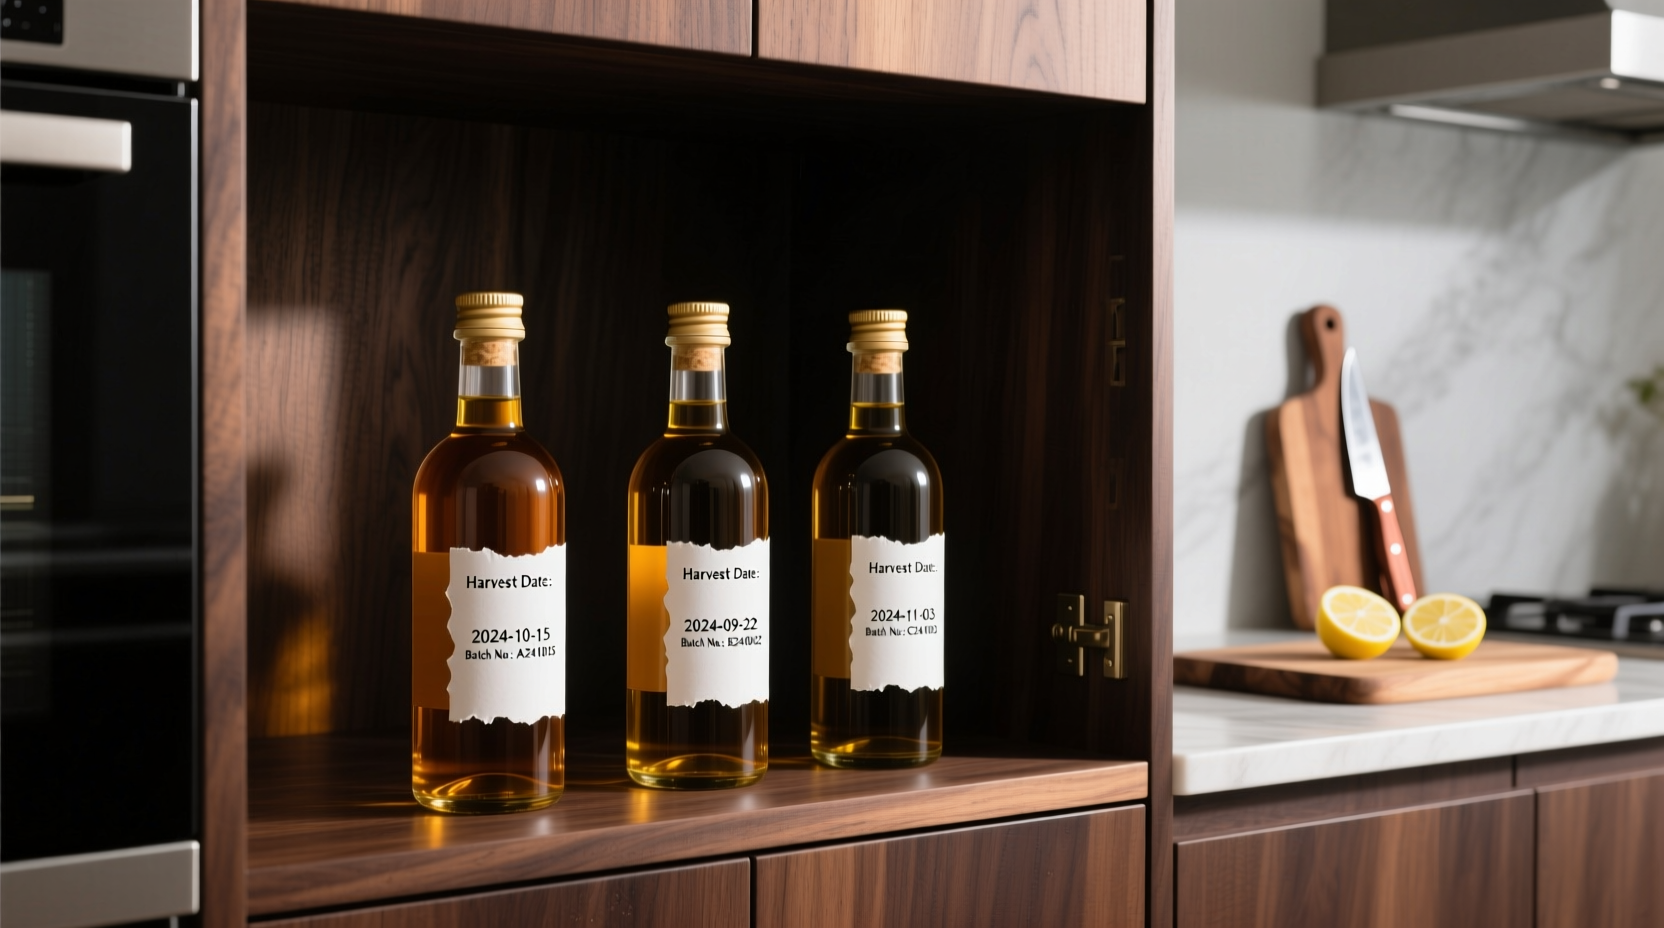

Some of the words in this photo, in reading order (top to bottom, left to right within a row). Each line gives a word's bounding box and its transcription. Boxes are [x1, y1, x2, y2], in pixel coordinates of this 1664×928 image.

[683, 567, 730, 580] Harvest
[734, 567, 760, 580] Date:
[869, 562, 912, 574] Harvest
[466, 575, 518, 589] Harvest
[521, 574, 552, 588] Date:
[870, 608, 936, 622] 2024-11-03
[684, 617, 758, 632] 2024-09-22
[471, 627, 551, 644] 2024-10-15
